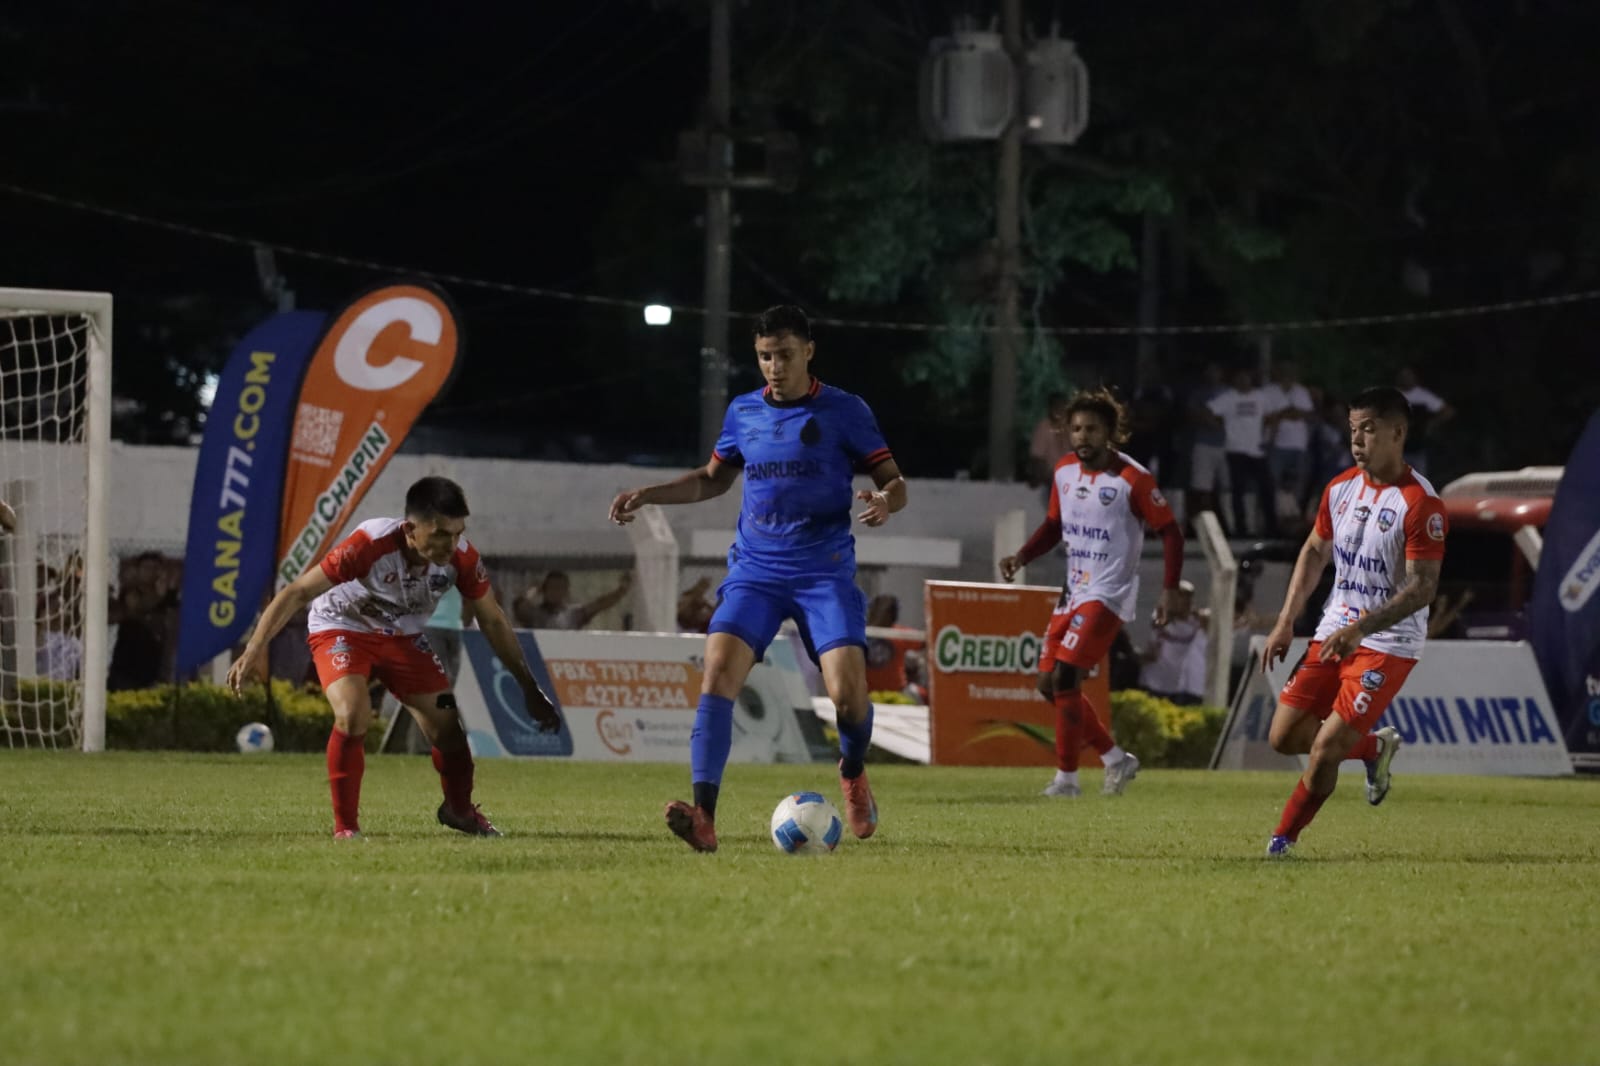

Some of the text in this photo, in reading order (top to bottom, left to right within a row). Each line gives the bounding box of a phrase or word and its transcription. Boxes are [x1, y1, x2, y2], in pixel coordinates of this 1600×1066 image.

[333, 297, 443, 392] C
[209, 351, 276, 628] GANA777.COM
[279, 426, 388, 587] REDICHAPIN
[1082, 525, 1111, 543] MITA
[1353, 691, 1373, 715] 6
[1455, 697, 1557, 744] MITA
